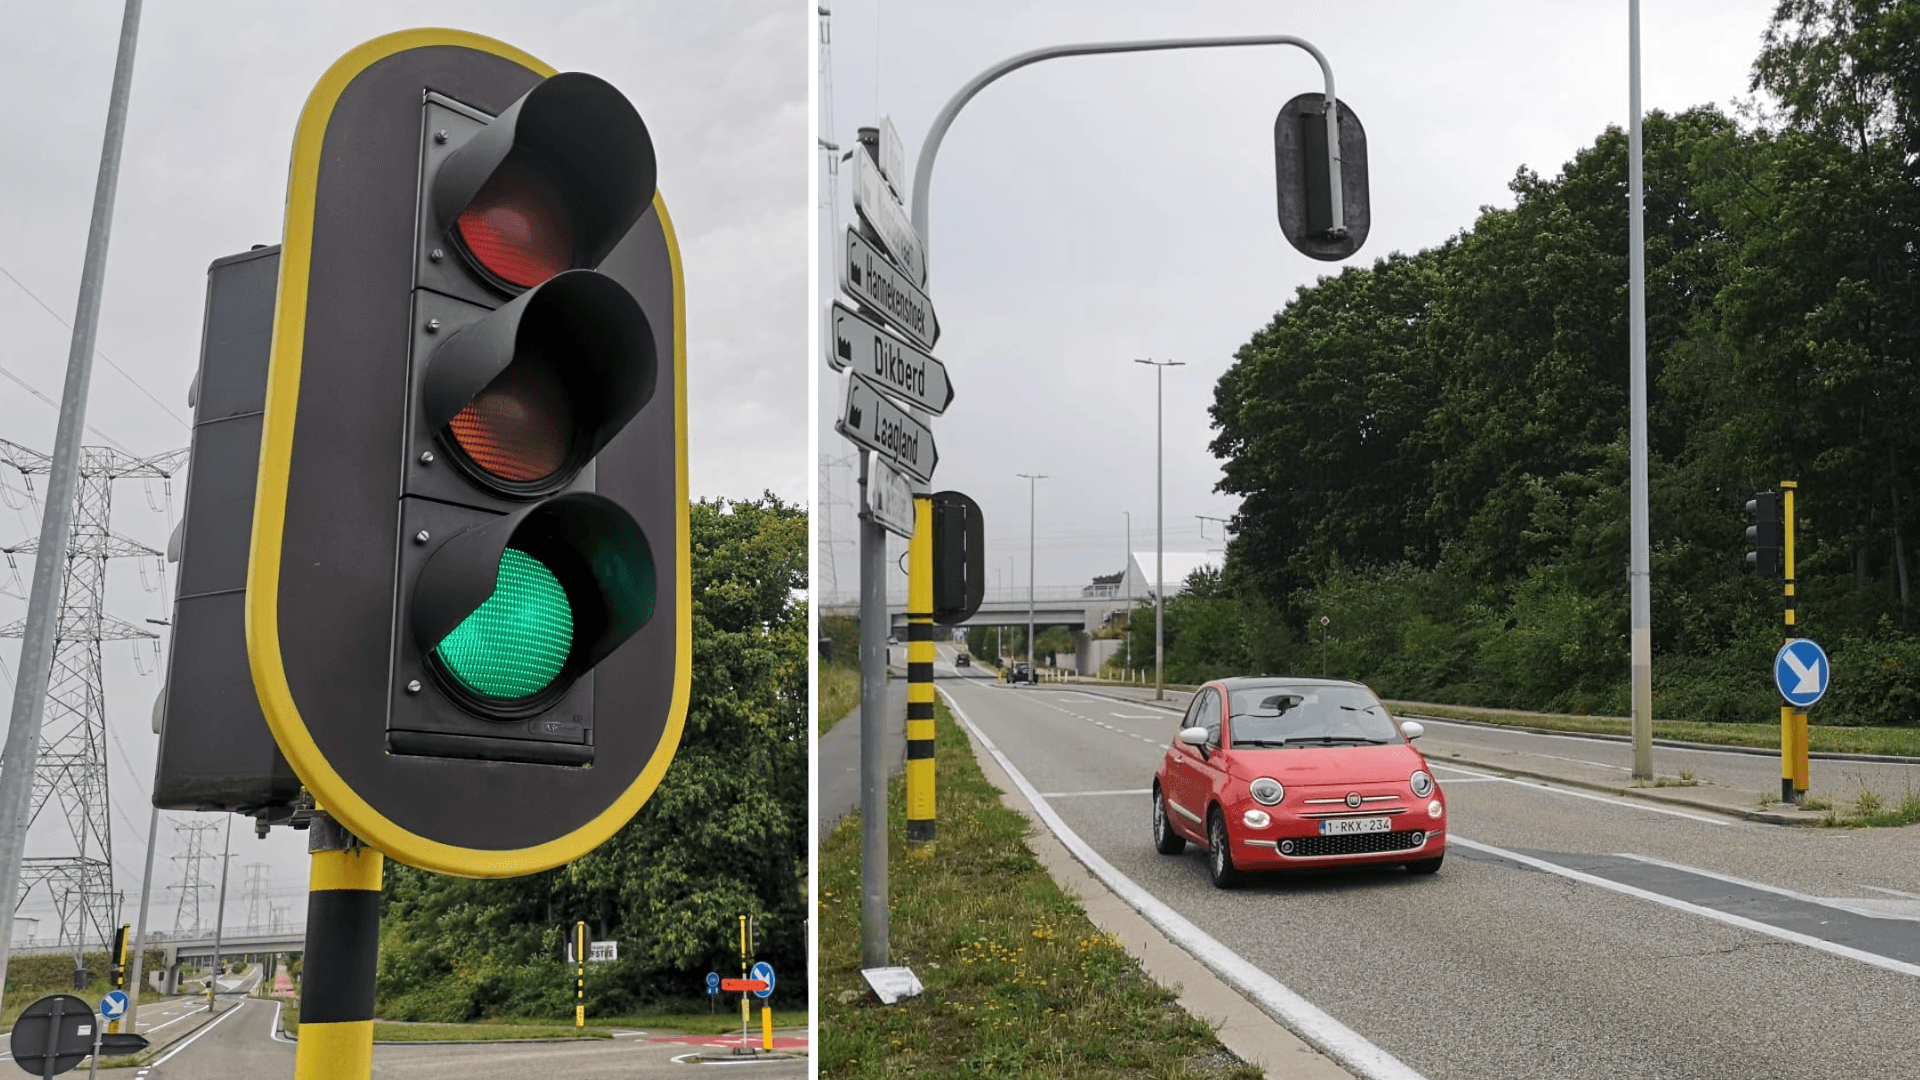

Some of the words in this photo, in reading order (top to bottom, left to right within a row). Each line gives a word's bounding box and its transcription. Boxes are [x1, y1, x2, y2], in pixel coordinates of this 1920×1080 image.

[866, 252, 927, 337] Hannekenshoek
[874, 335, 926, 397] Dikberd
[874, 401, 919, 465] Laagland
